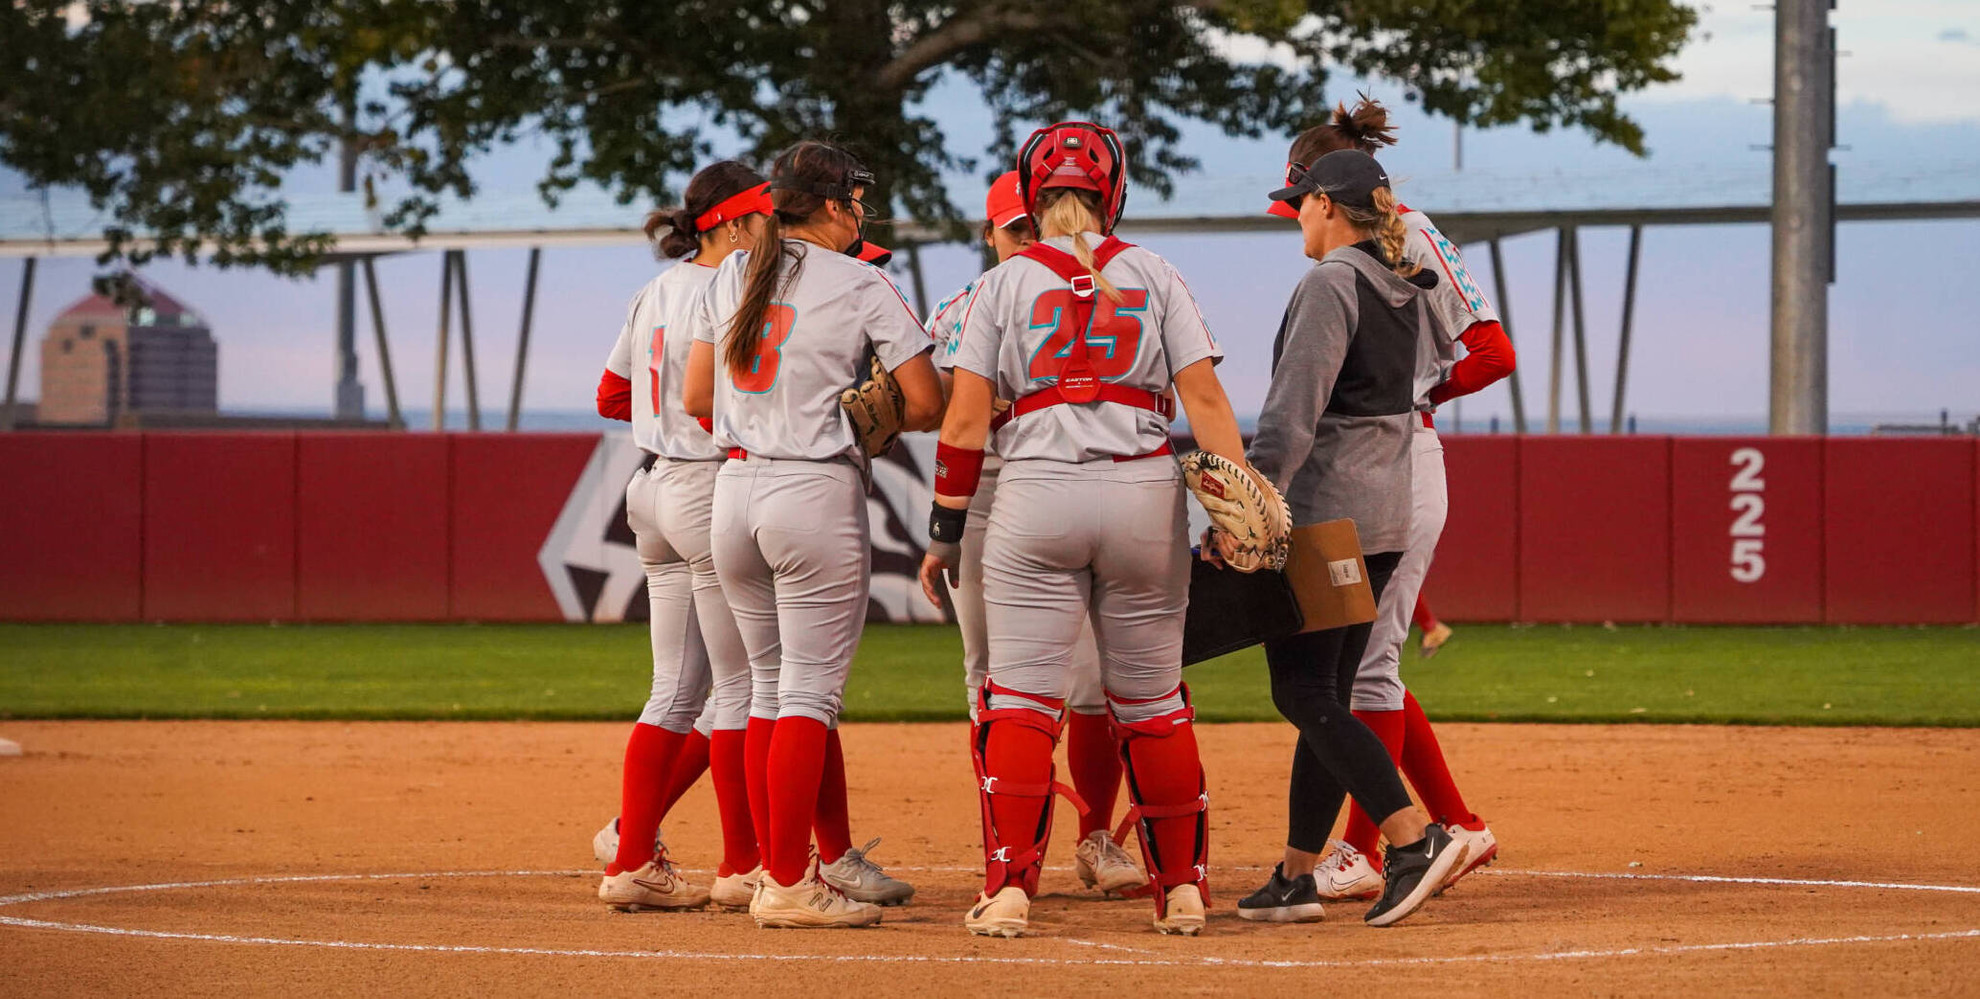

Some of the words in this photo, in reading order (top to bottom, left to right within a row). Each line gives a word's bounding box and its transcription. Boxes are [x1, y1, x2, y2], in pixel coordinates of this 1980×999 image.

[648, 324, 668, 418] 1
[1028, 287, 1150, 382] 25
[1730, 447, 1765, 582] 225
